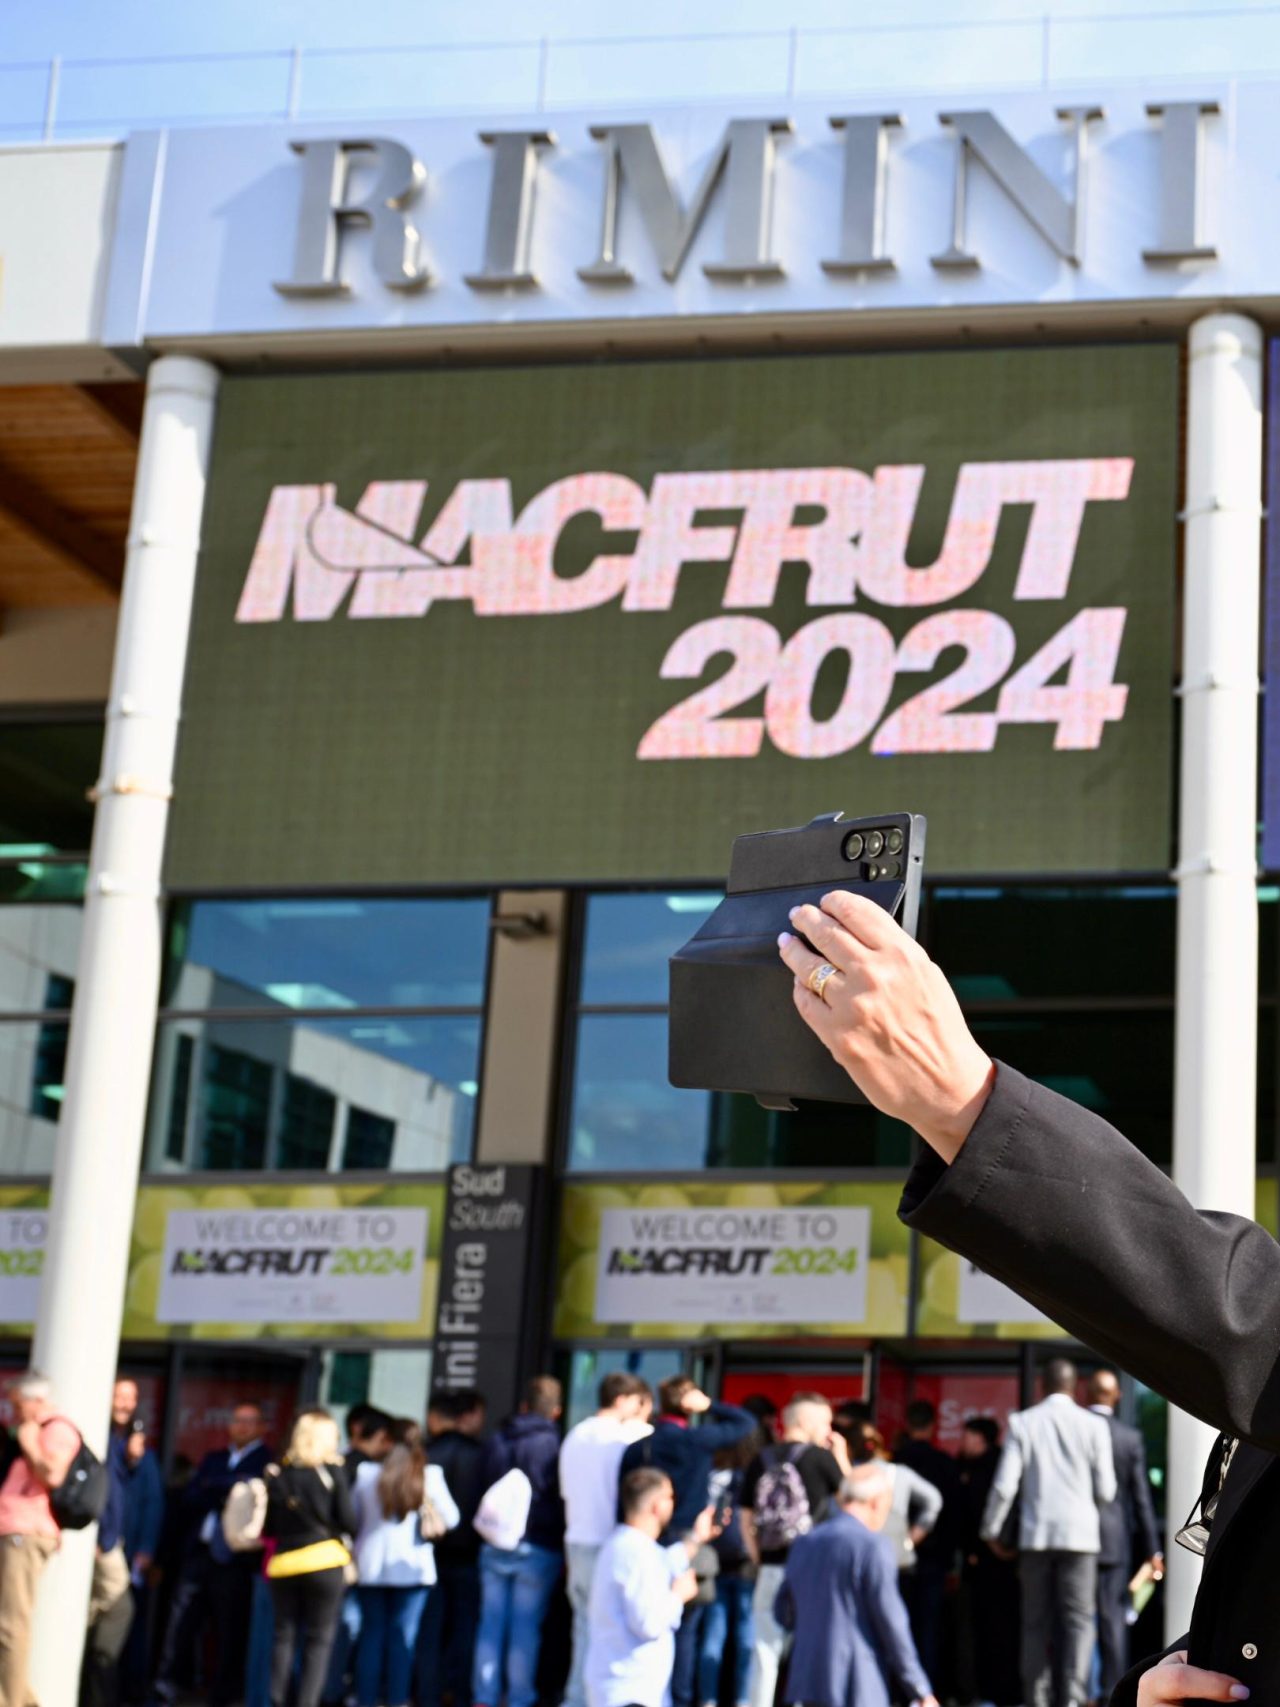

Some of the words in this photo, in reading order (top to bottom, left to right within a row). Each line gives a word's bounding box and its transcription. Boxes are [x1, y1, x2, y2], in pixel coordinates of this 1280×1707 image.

[272, 100, 1221, 299] RIMINI
[235, 457, 1135, 623] MACFRUT
[636, 606, 1129, 759] 2024
[452, 1165, 506, 1197] Sud
[9, 1214, 50, 1246] TO
[195, 1213, 345, 1243] WELCOME
[357, 1213, 398, 1243] TO
[451, 1199, 526, 1232] South
[631, 1213, 786, 1242] WELCOME
[794, 1213, 839, 1242] TO
[170, 1248, 331, 1276] MACFRUT
[330, 1247, 414, 1276] 2024
[607, 1248, 772, 1276] MACFRUT
[771, 1247, 858, 1276] 2024
[440, 1243, 488, 1334] Fiera
